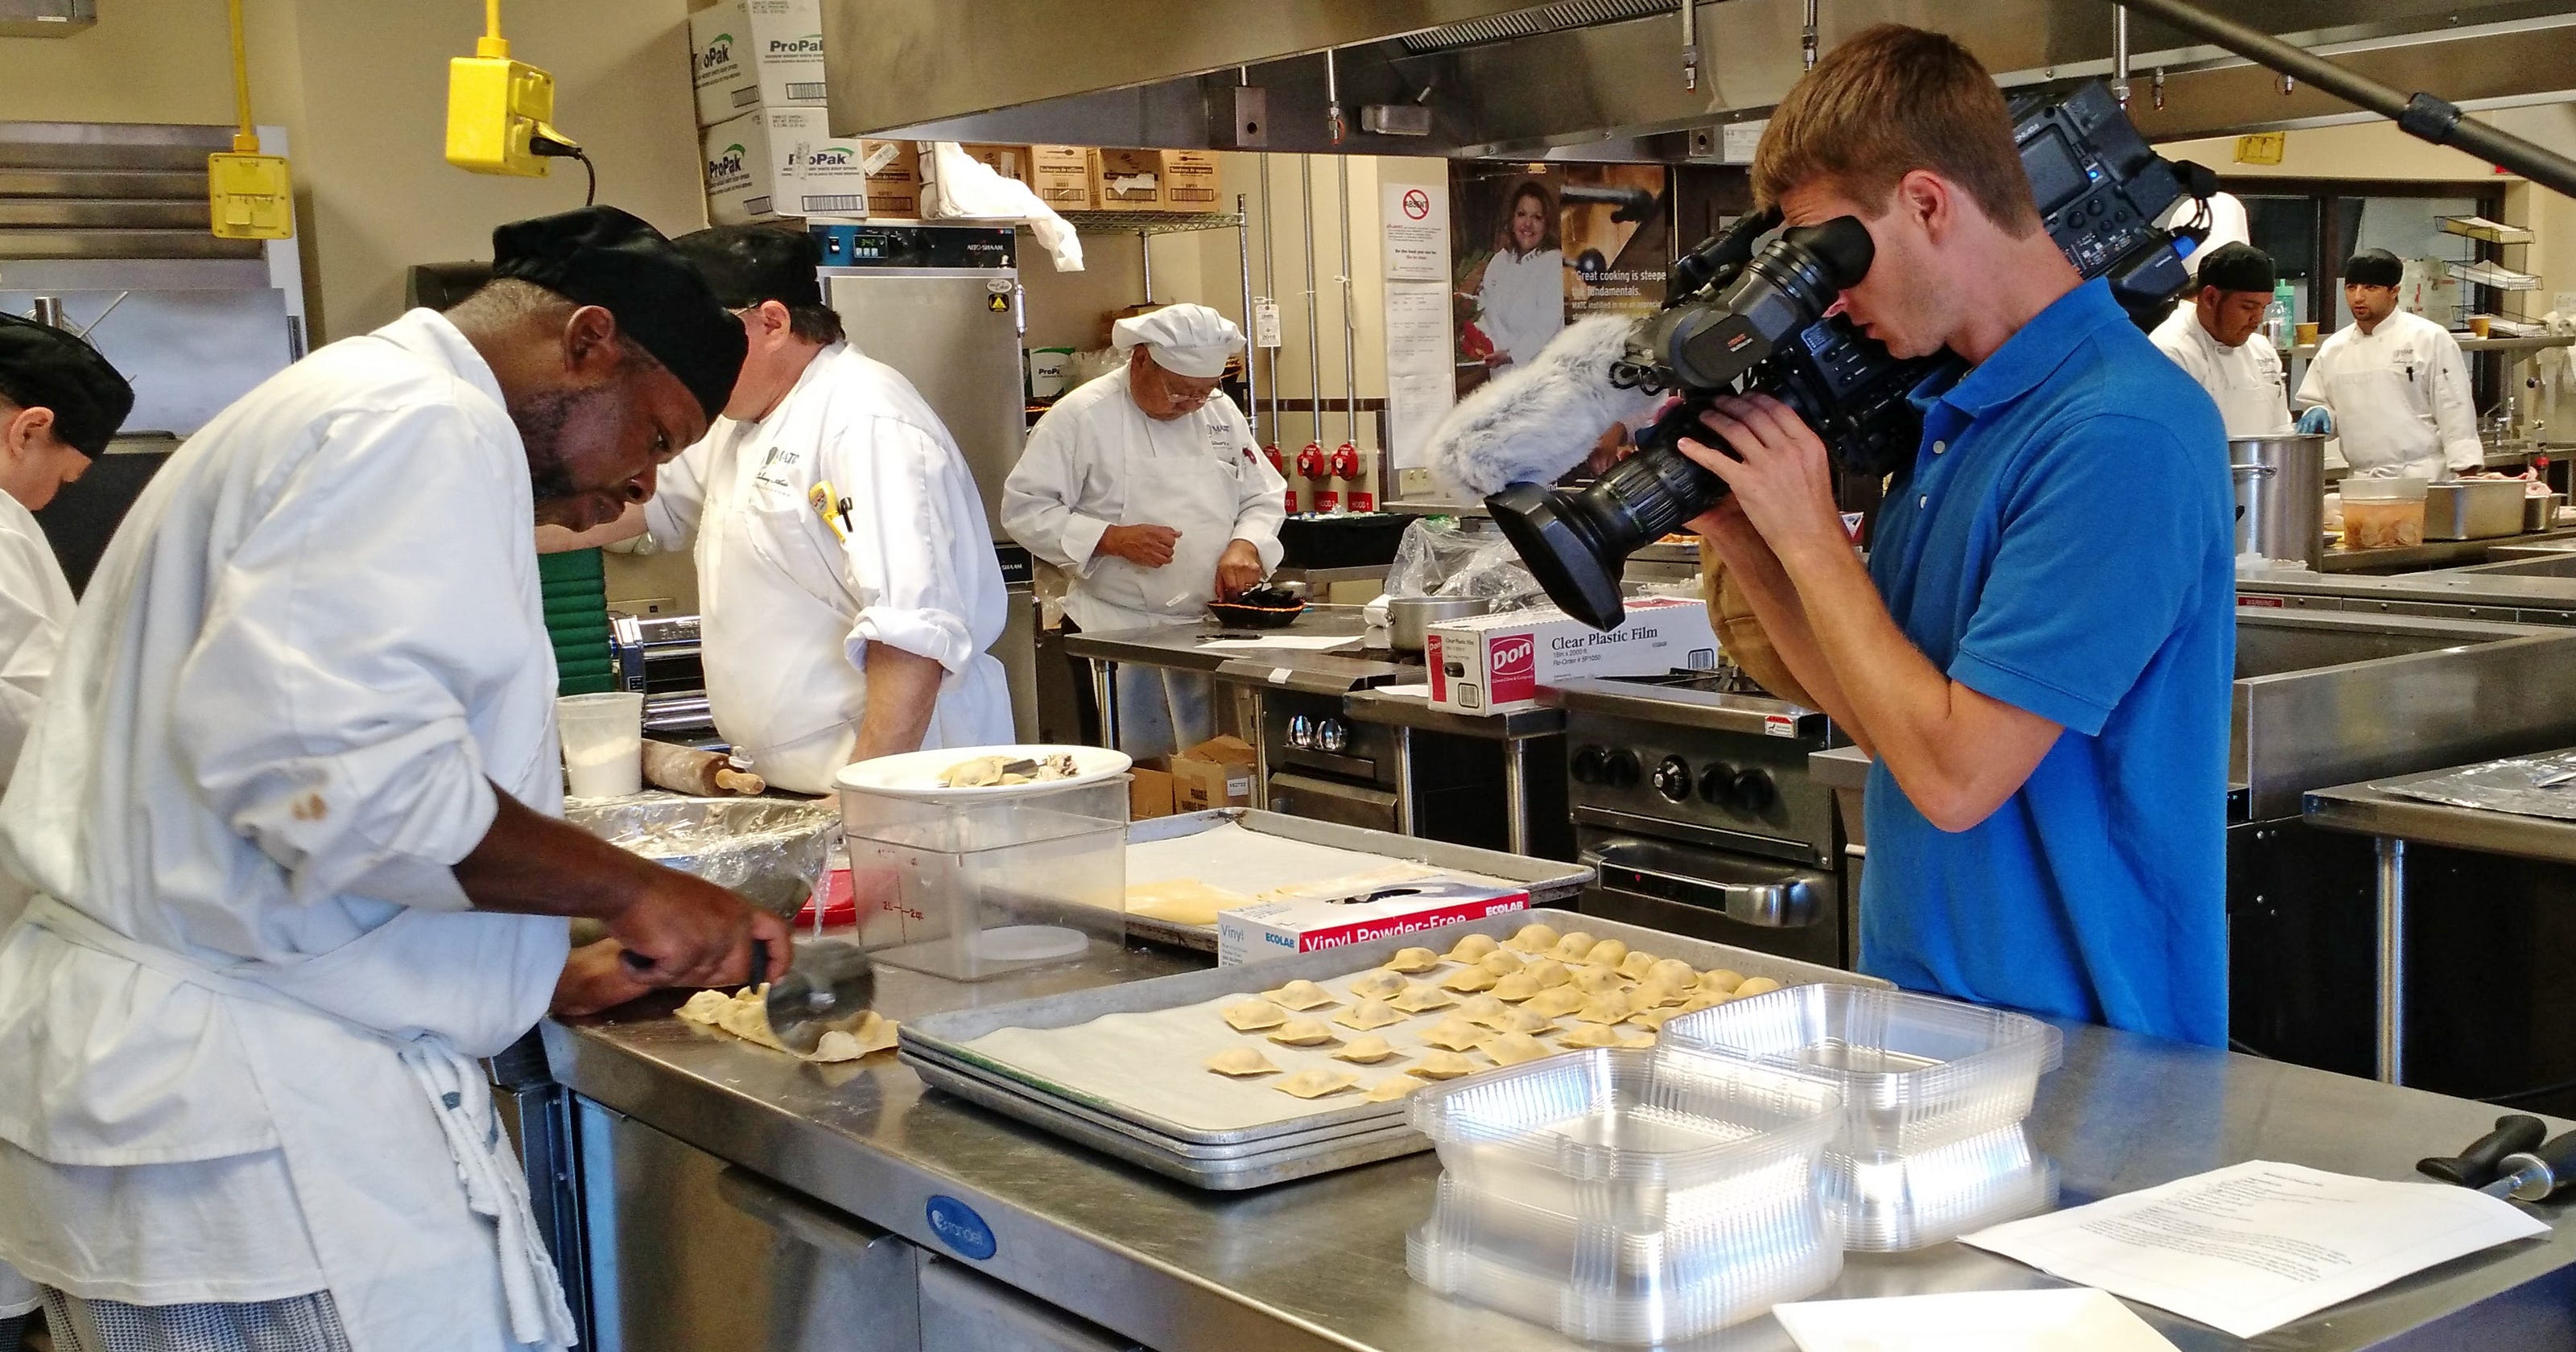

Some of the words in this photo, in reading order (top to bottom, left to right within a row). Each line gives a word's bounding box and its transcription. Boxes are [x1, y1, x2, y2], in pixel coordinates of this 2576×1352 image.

[709, 154, 742, 179] ProPak
[788, 154, 846, 166] PoPak
[1600, 270, 1630, 282] cooking
[1632, 270, 1639, 281] is
[1641, 270, 1666, 282] steepe
[1551, 637, 1584, 650] Clear
[1588, 630, 1628, 645] Plastic
[1631, 626, 1658, 641] Film
[1494, 642, 1531, 670] Don
[1486, 901, 1525, 917] ECOLAB
[1220, 924, 1245, 942] Vinyl
[1357, 913, 1467, 943] Powder-Free
[1265, 932, 1294, 948] ECOLAB
